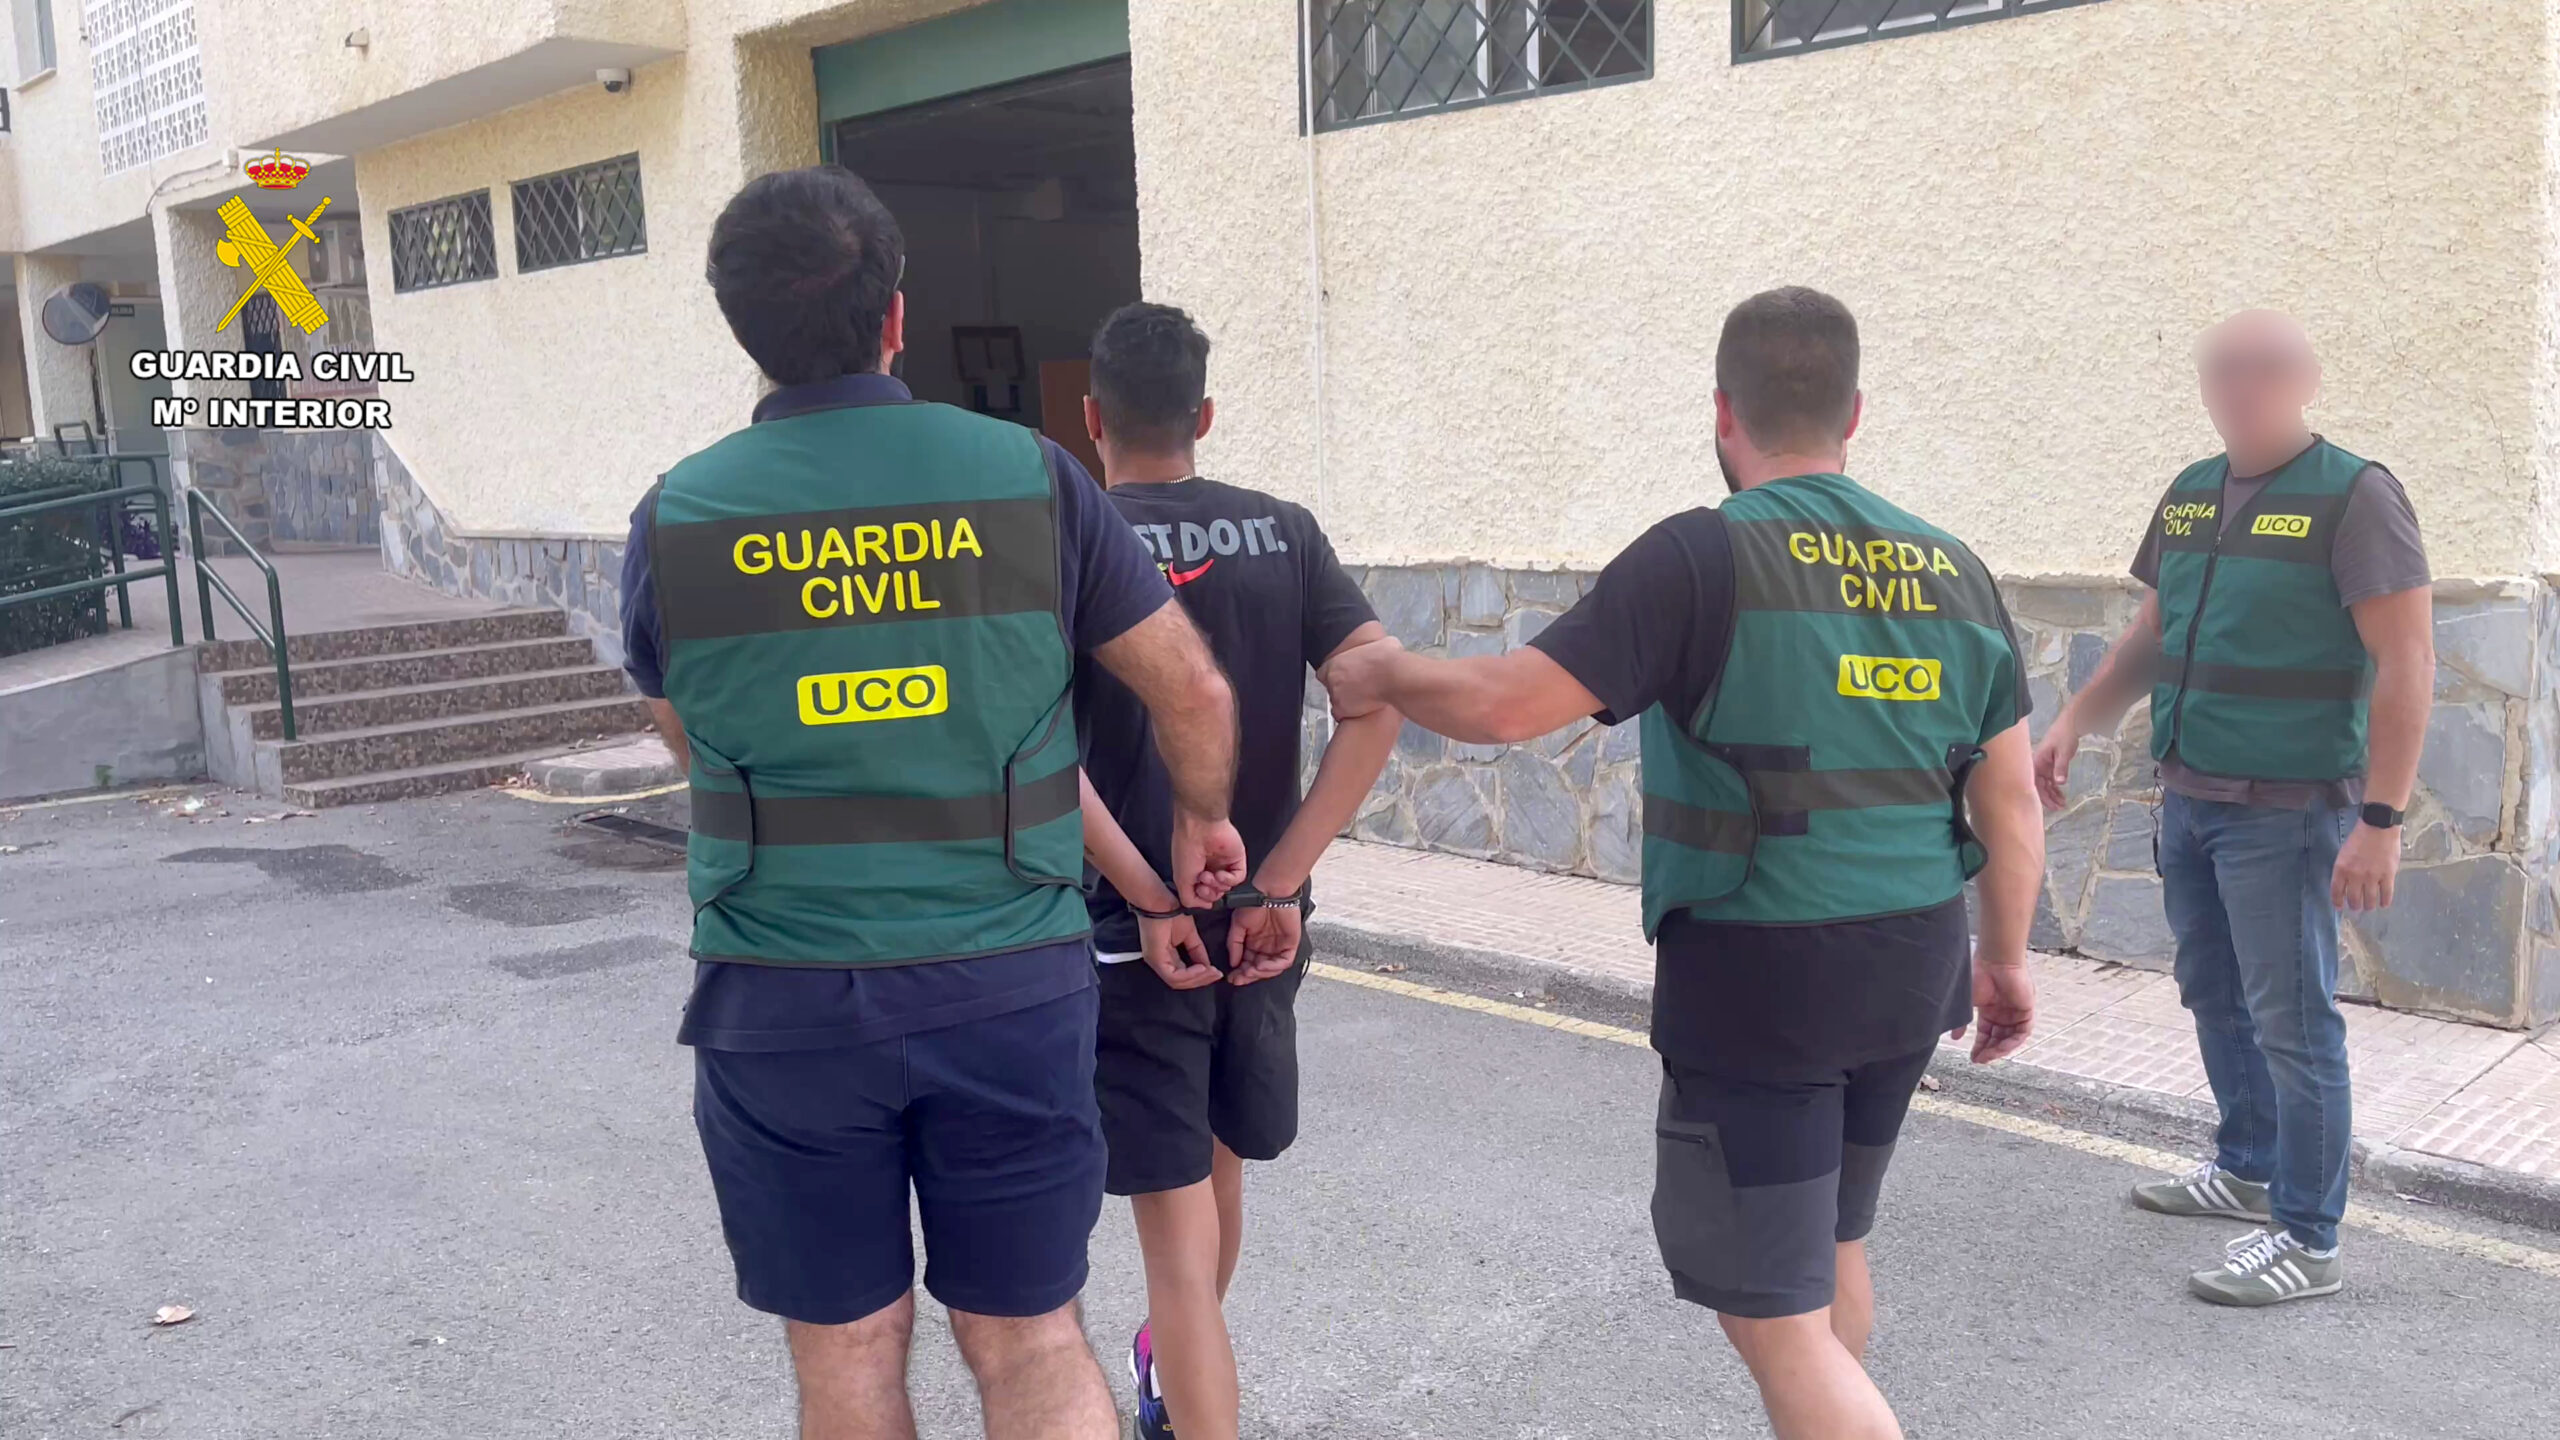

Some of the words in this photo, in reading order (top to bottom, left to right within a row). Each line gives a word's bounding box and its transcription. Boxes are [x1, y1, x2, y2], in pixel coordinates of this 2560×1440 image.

[733, 517, 983, 575] GUARDIA
[1179, 518, 1241, 562] DO
[1241, 516, 1288, 556] IT.
[2256, 516, 2305, 534] UCO
[1788, 531, 1960, 577] GUARDIA
[801, 569, 941, 618] CIVIL
[1840, 573, 1938, 612] CIVIL
[811, 674, 937, 716] UCO
[1848, 659, 1933, 694] UCO
